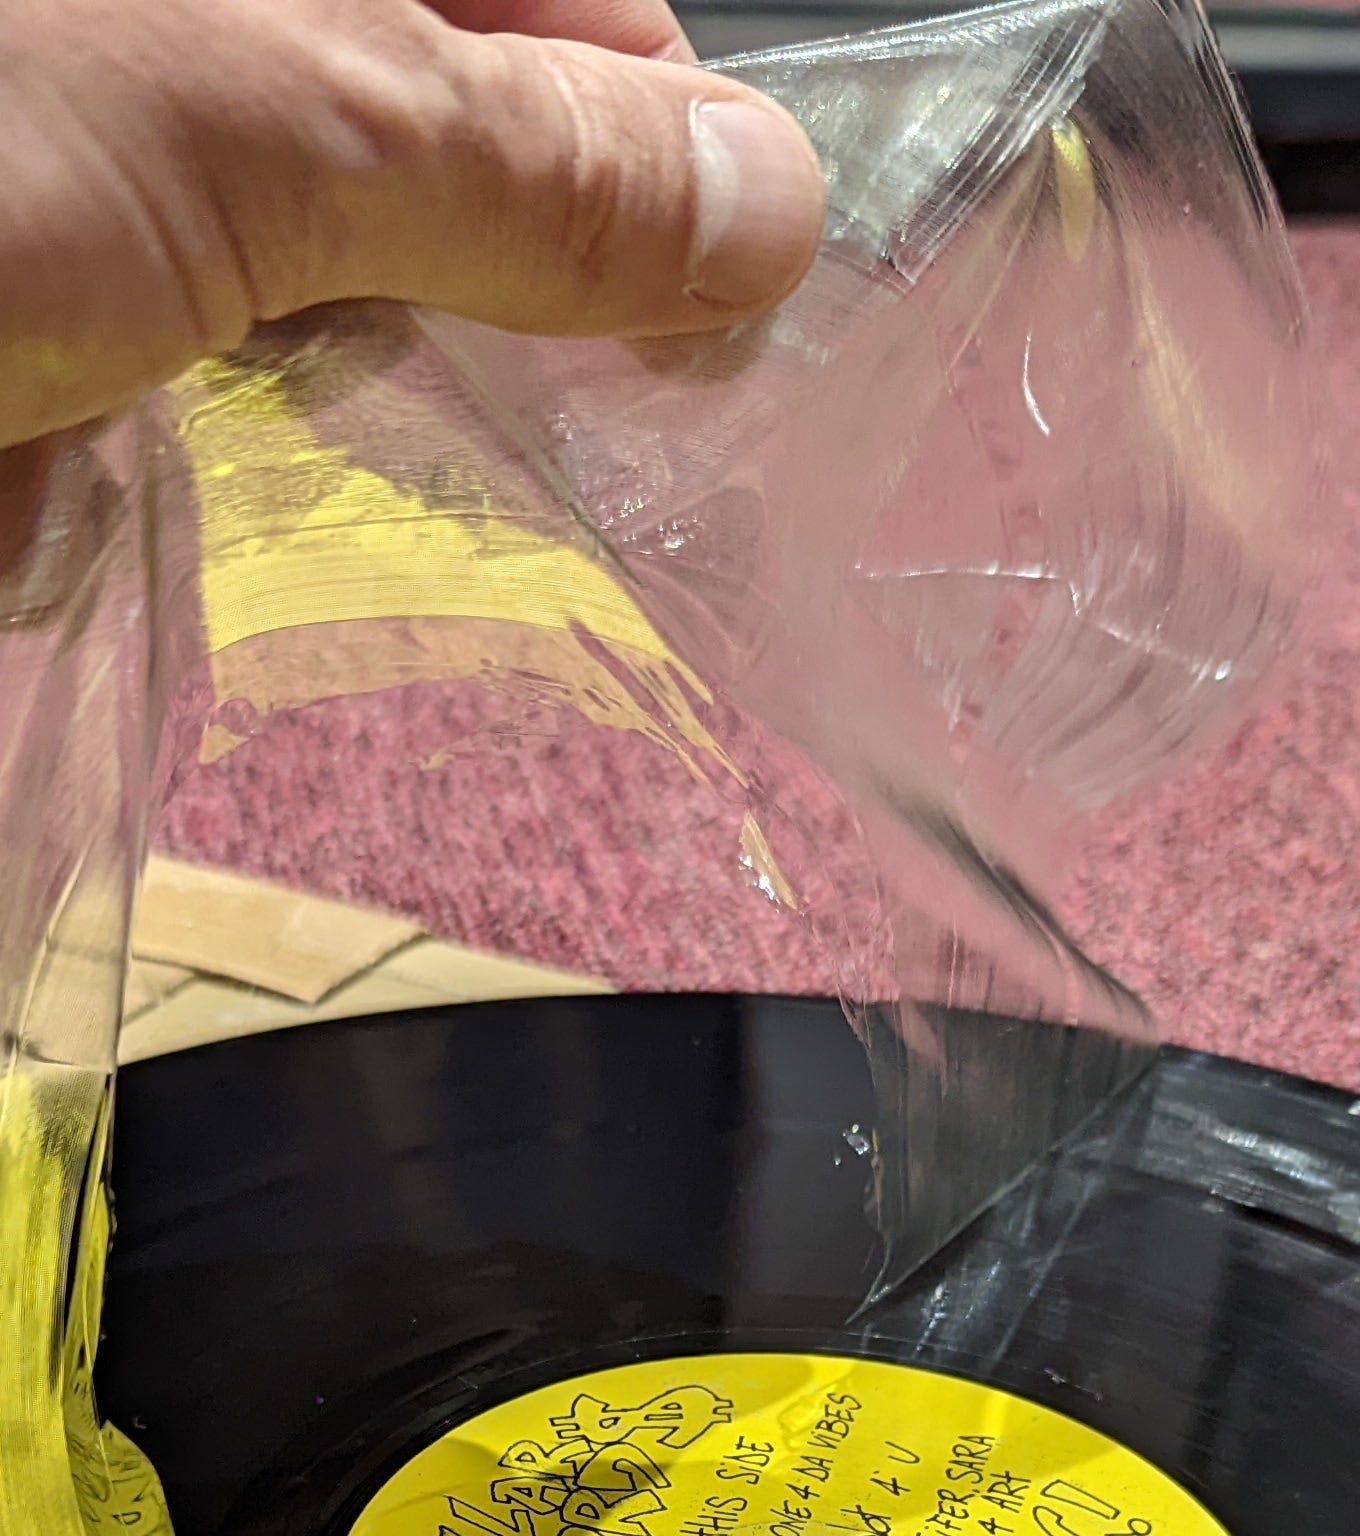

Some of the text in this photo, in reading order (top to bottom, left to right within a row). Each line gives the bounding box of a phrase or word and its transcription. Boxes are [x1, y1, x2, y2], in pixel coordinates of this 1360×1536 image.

[884, 1441, 921, 1465] U
[946, 1435, 995, 1485] SARA
[792, 1455, 833, 1482] DA
[786, 1482, 821, 1501] 4
[870, 1470, 911, 1496] 4
[977, 1517, 1015, 1536] 4
